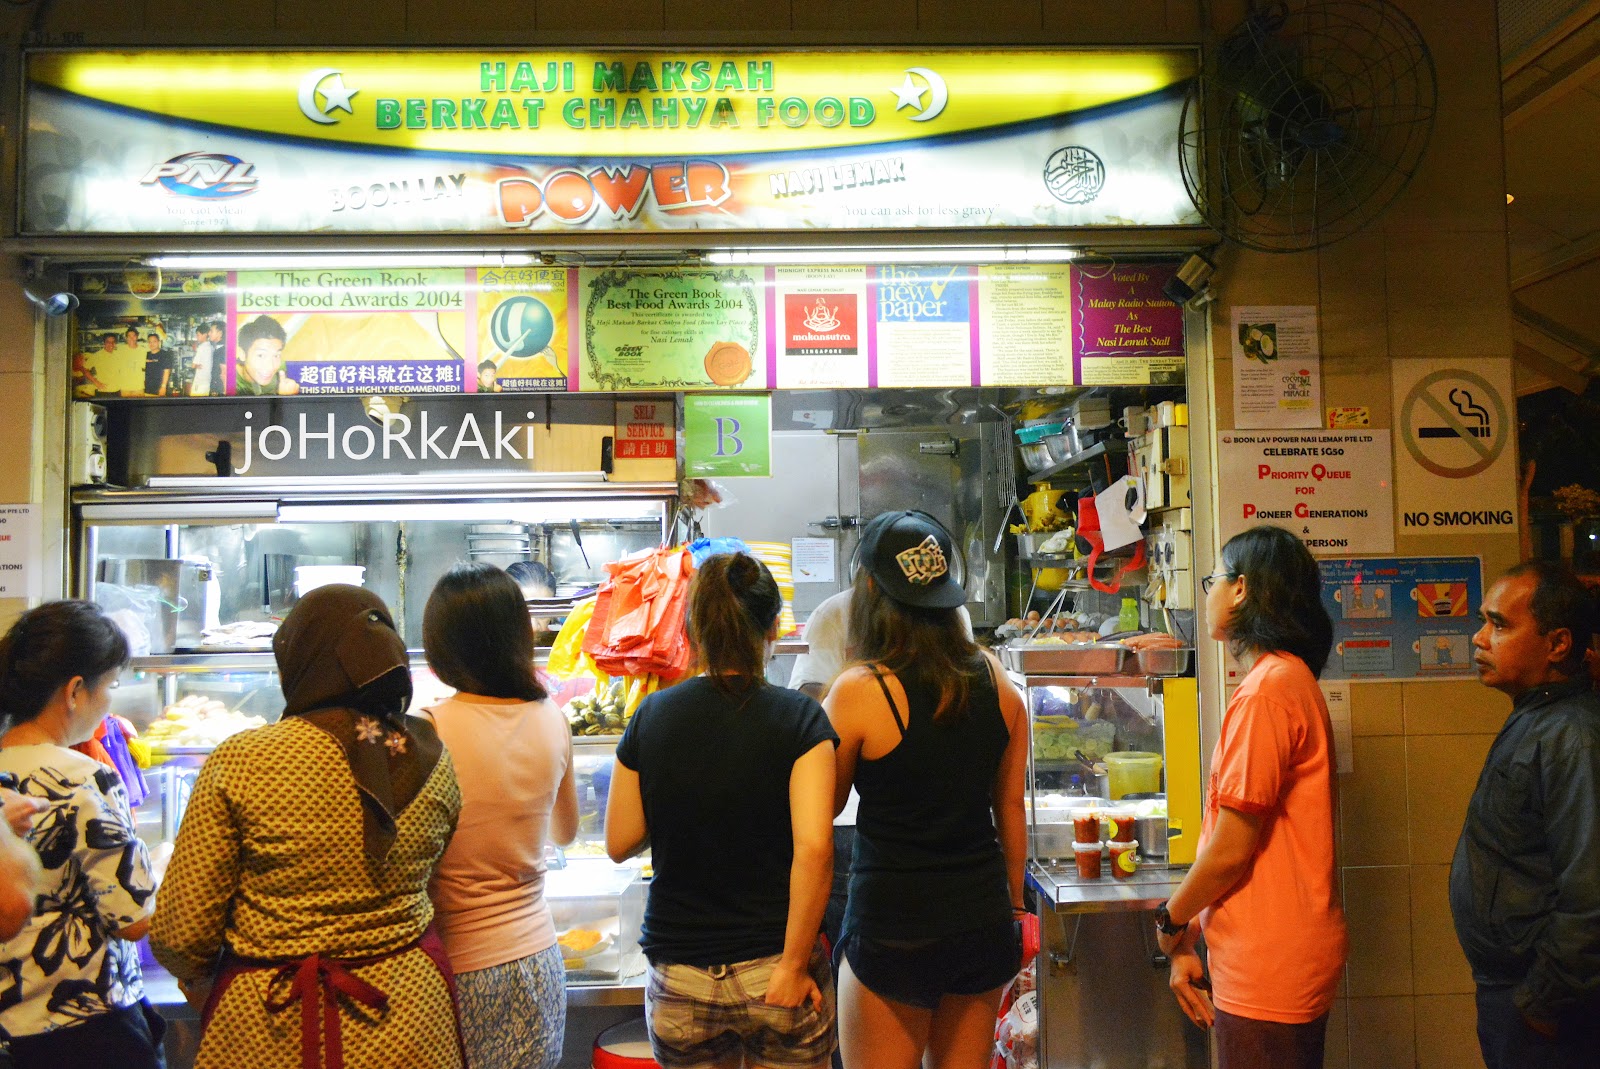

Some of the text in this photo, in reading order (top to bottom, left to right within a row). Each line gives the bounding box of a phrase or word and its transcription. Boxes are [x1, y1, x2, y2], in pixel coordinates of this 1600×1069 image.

[480, 60, 774, 92] HAJI MAKSAH
[376, 96, 876, 129] BERKAT CHAHYA FOOD
[139, 162, 259, 187] PNL
[769, 157, 906, 199] NASI LEMAK
[328, 173, 466, 212] BOON LAY
[497, 159, 732, 227] POWER
[870, 207, 892, 216] can
[895, 205, 914, 216] ask
[918, 204, 934, 216] for
[938, 204, 959, 215] less
[182, 218, 229, 226] Since 1971
[275, 271, 429, 288] The Green Book
[880, 264, 919, 286] the
[1112, 273, 1149, 283] Voted By
[627, 288, 722, 299] The Green Book
[880, 285, 930, 302] new
[1128, 286, 1135, 295] A
[240, 290, 463, 308] Best Food Awards 2004
[607, 299, 743, 309] Best Food Awards 2004
[1088, 299, 1176, 310] Malay Radio Station
[880, 300, 948, 322] paper
[1126, 312, 1138, 321] As
[1114, 324, 1152, 334] The Best
[669, 336, 694, 344] Lemak
[792, 332, 851, 341] makansutra
[1096, 337, 1171, 347] Nasi Lemak Stall
[300, 364, 461, 384] 超值好料就在这摊!
[300, 385, 461, 395] THIS STALL IS HIGHLY RECOMMENDED!
[634, 404, 656, 420] SELF
[627, 423, 665, 438] SERVICE
[711, 416, 744, 458] B
[623, 442, 668, 456] 請自助
[1263, 448, 1345, 456] CELEBRATE SG50
[1258, 463, 1351, 481] PRIORITY QUEUE
[1295, 486, 1315, 495] FOR
[1243, 502, 1368, 519] PIONEER GENERATIONS
[1404, 510, 1513, 527] NO SMOKING
[1302, 526, 1310, 534] &
[1306, 539, 1348, 547] PERSONS
